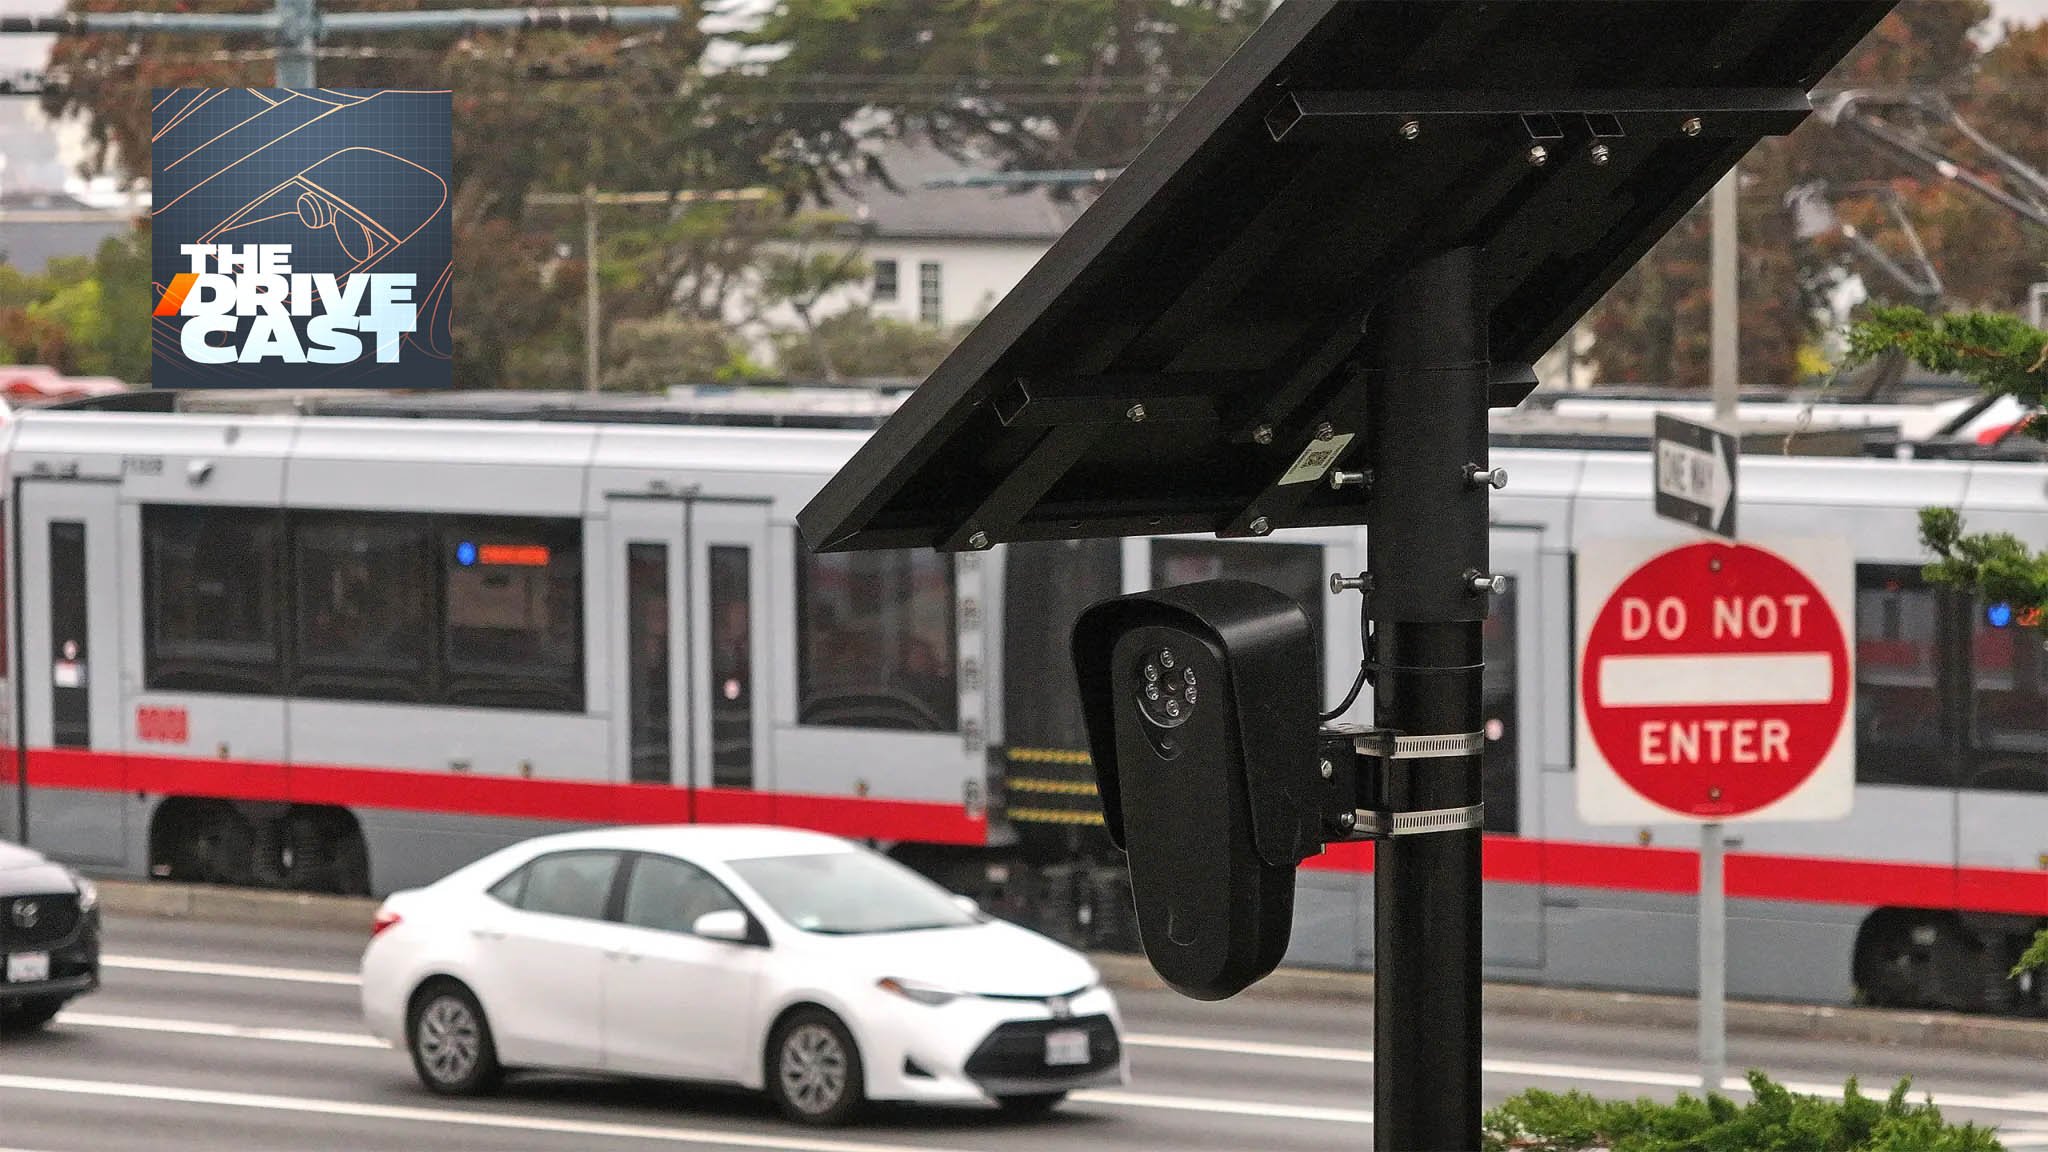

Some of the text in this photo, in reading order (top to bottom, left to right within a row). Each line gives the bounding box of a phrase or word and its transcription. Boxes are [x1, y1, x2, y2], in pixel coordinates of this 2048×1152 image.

[1661, 447, 1686, 492] ONE
[1621, 594, 1809, 641] DO NOT
[1639, 718, 1791, 766] ENTER
